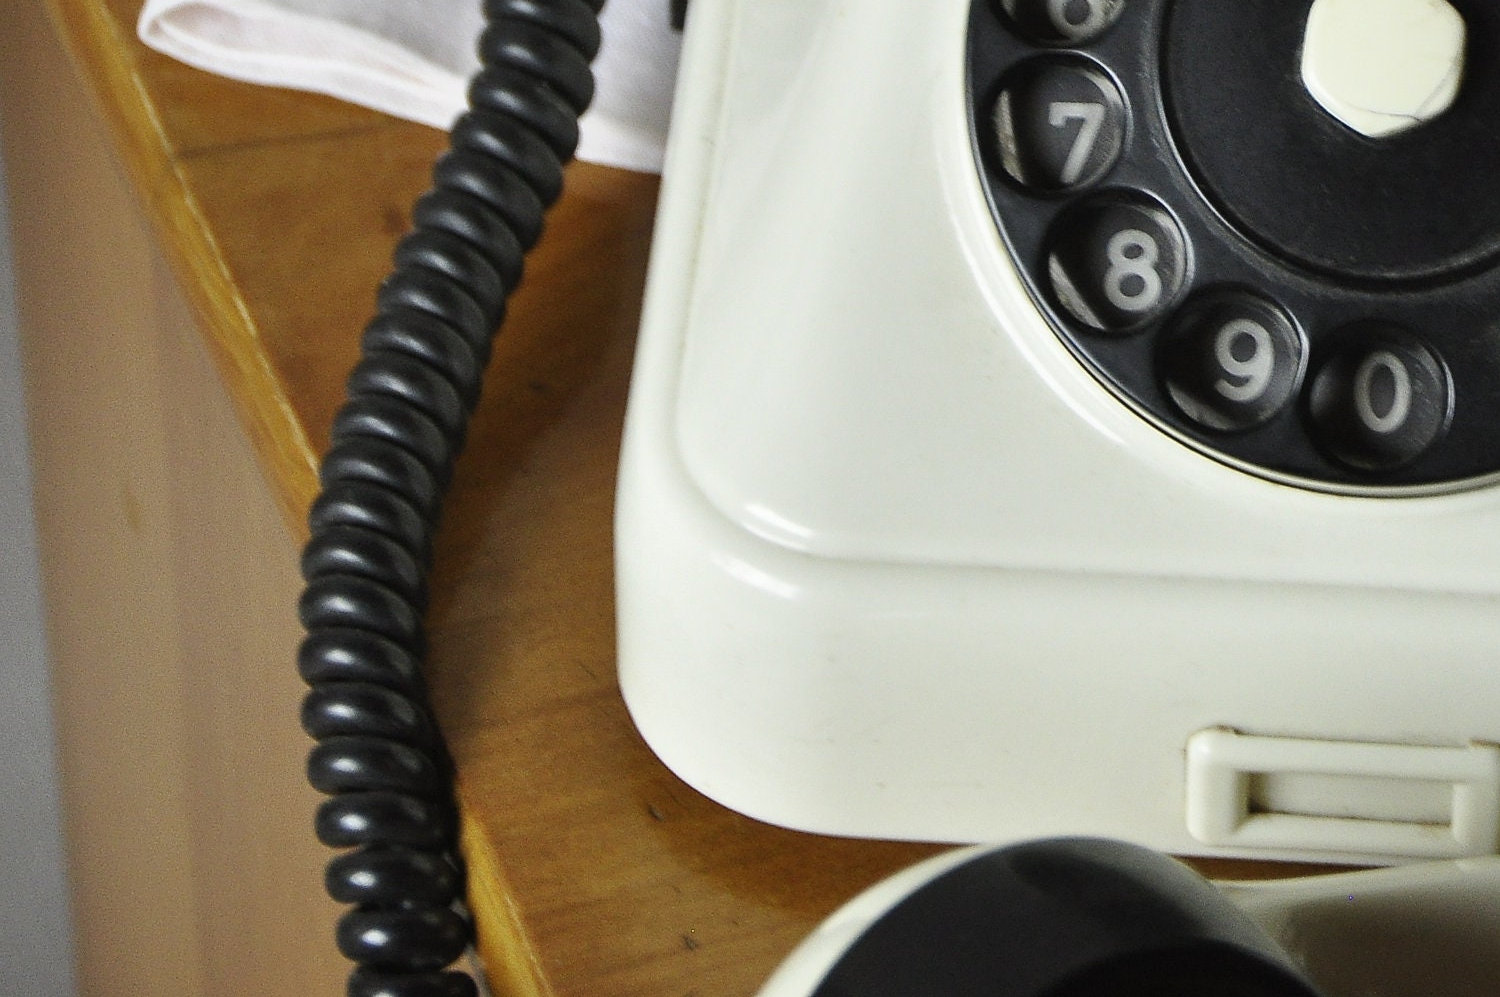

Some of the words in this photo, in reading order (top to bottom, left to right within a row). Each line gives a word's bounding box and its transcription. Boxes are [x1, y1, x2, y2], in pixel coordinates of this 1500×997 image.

[1050, 102, 1105, 184] 7
[1103, 228, 1162, 312] 8
[1213, 318, 1275, 403] 9
[1354, 350, 1412, 434] 0
